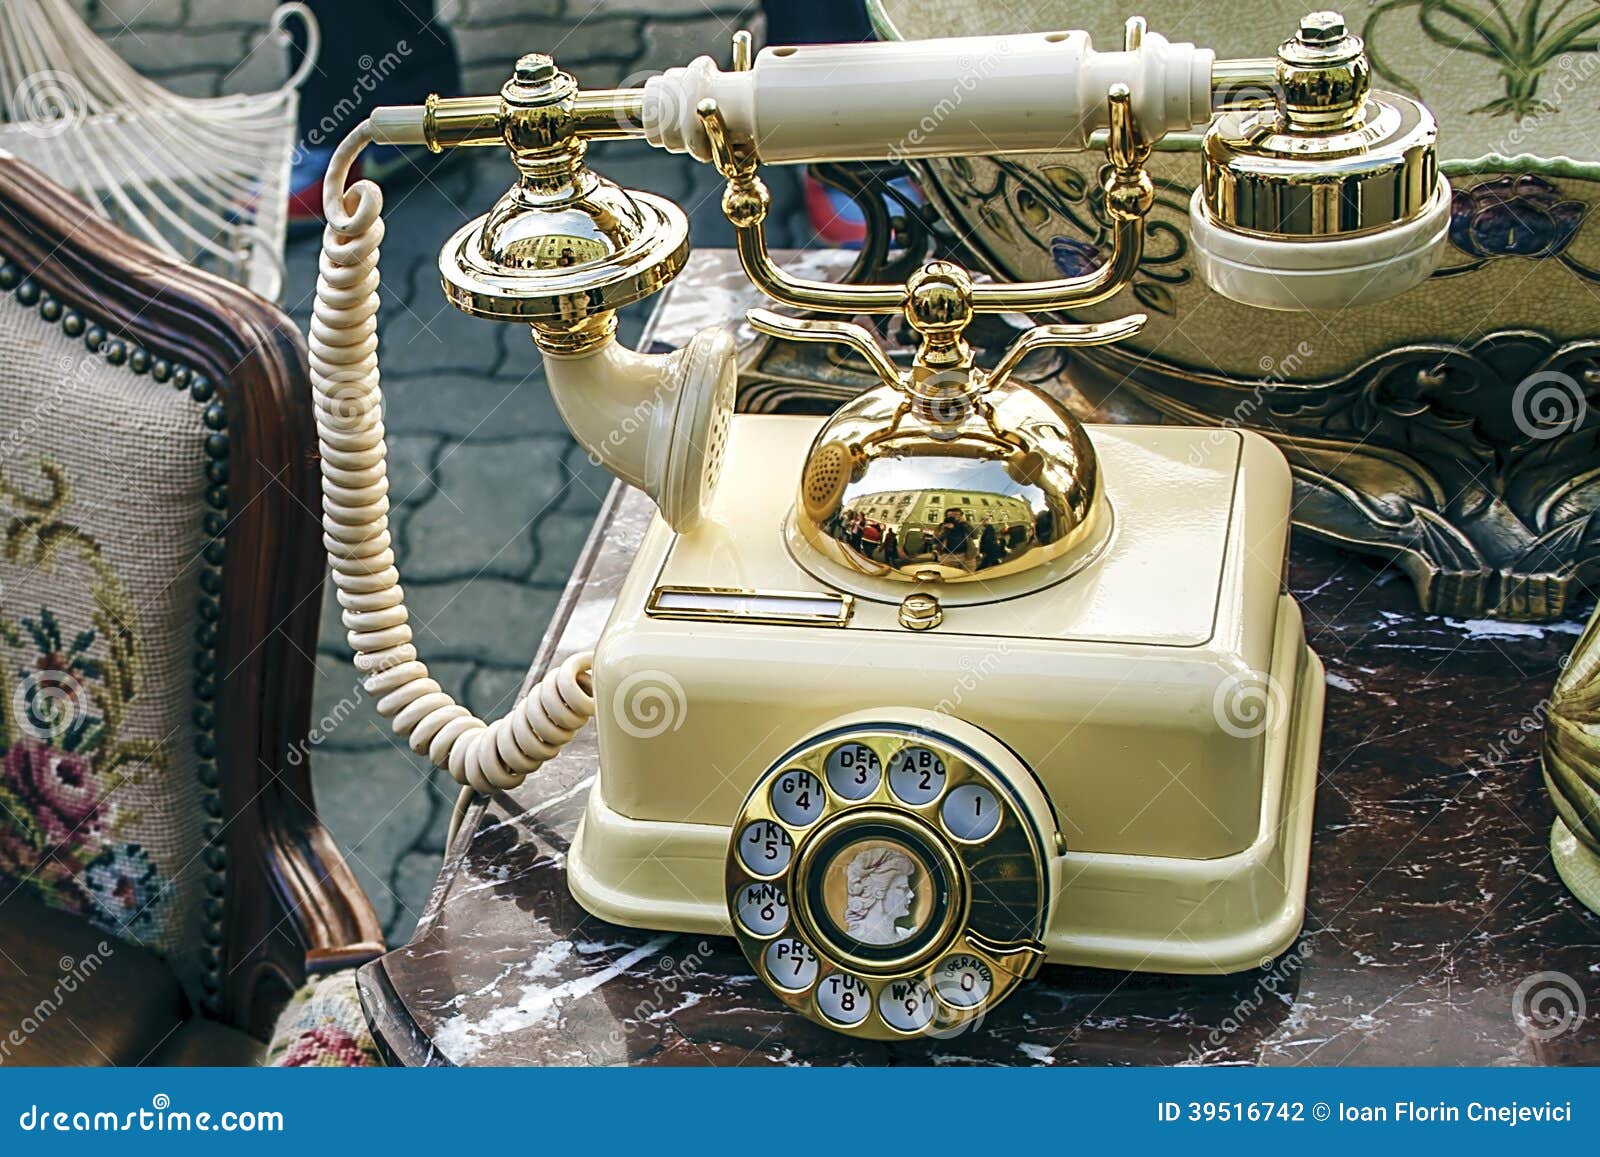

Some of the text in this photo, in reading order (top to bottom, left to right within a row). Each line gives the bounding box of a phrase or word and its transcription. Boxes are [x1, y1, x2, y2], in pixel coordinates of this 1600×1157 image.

[841, 746, 879, 768] DEF
[902, 751, 945, 775] ABC
[855, 765, 867, 784] 3
[919, 770, 931, 790] 2
[795, 791, 810, 811] 4
[974, 796, 981, 816] 1
[764, 840, 778, 860] 5
[760, 902, 775, 921] 6
[790, 956, 804, 976] 7
[944, 956, 992, 982] OPERATOR
[841, 992, 855, 1012] 8
[904, 998, 919, 1017] 9
